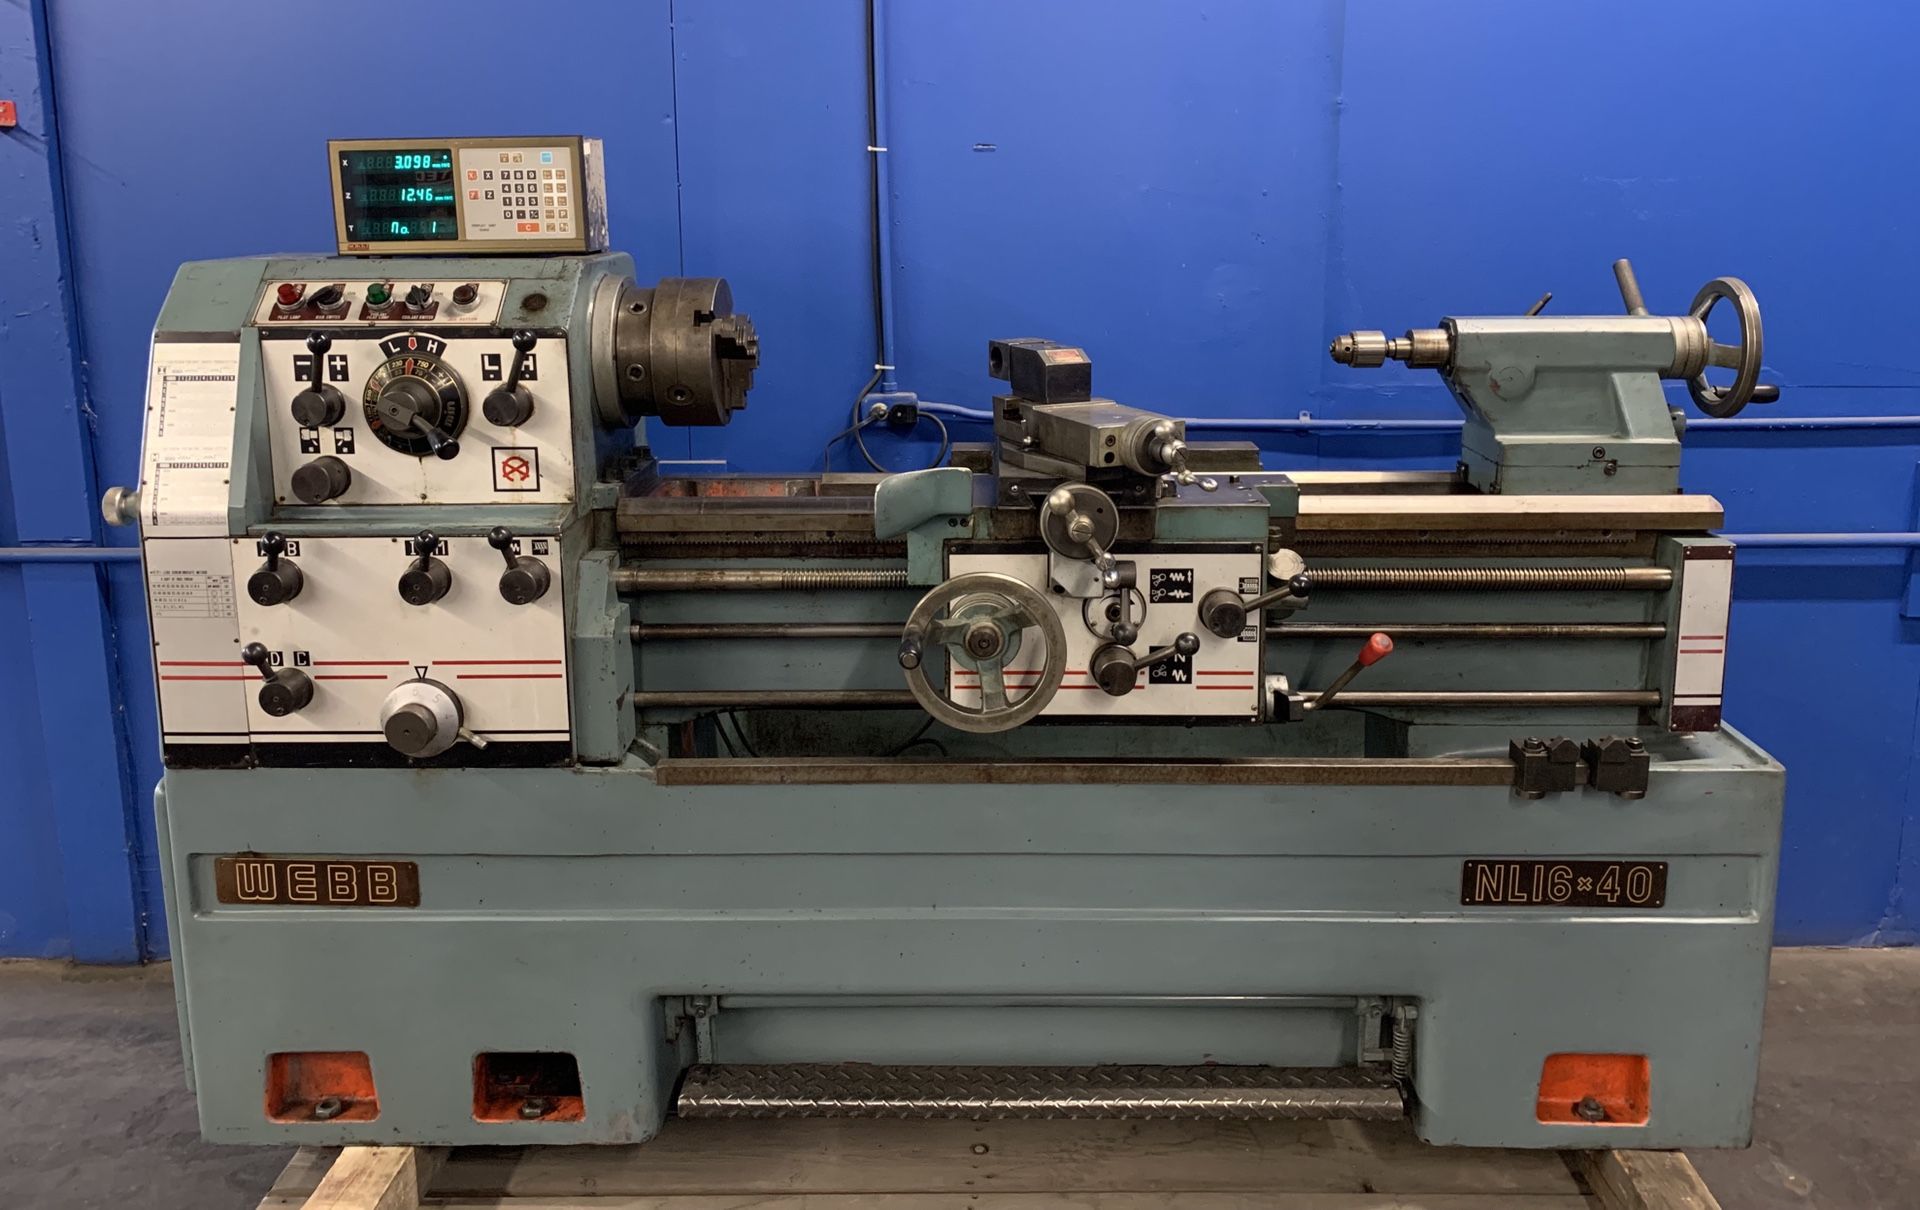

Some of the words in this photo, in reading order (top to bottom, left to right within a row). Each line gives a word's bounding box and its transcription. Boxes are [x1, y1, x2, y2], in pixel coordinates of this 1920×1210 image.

[401, 188, 433, 201] 12.46
[387, 341, 401, 353] L
[426, 339, 438, 354] H
[483, 355, 499, 370] L
[287, 542, 297, 556] B
[270, 651, 280, 666] D
[296, 651, 307, 666] C
[235, 863, 398, 902] WEBB
